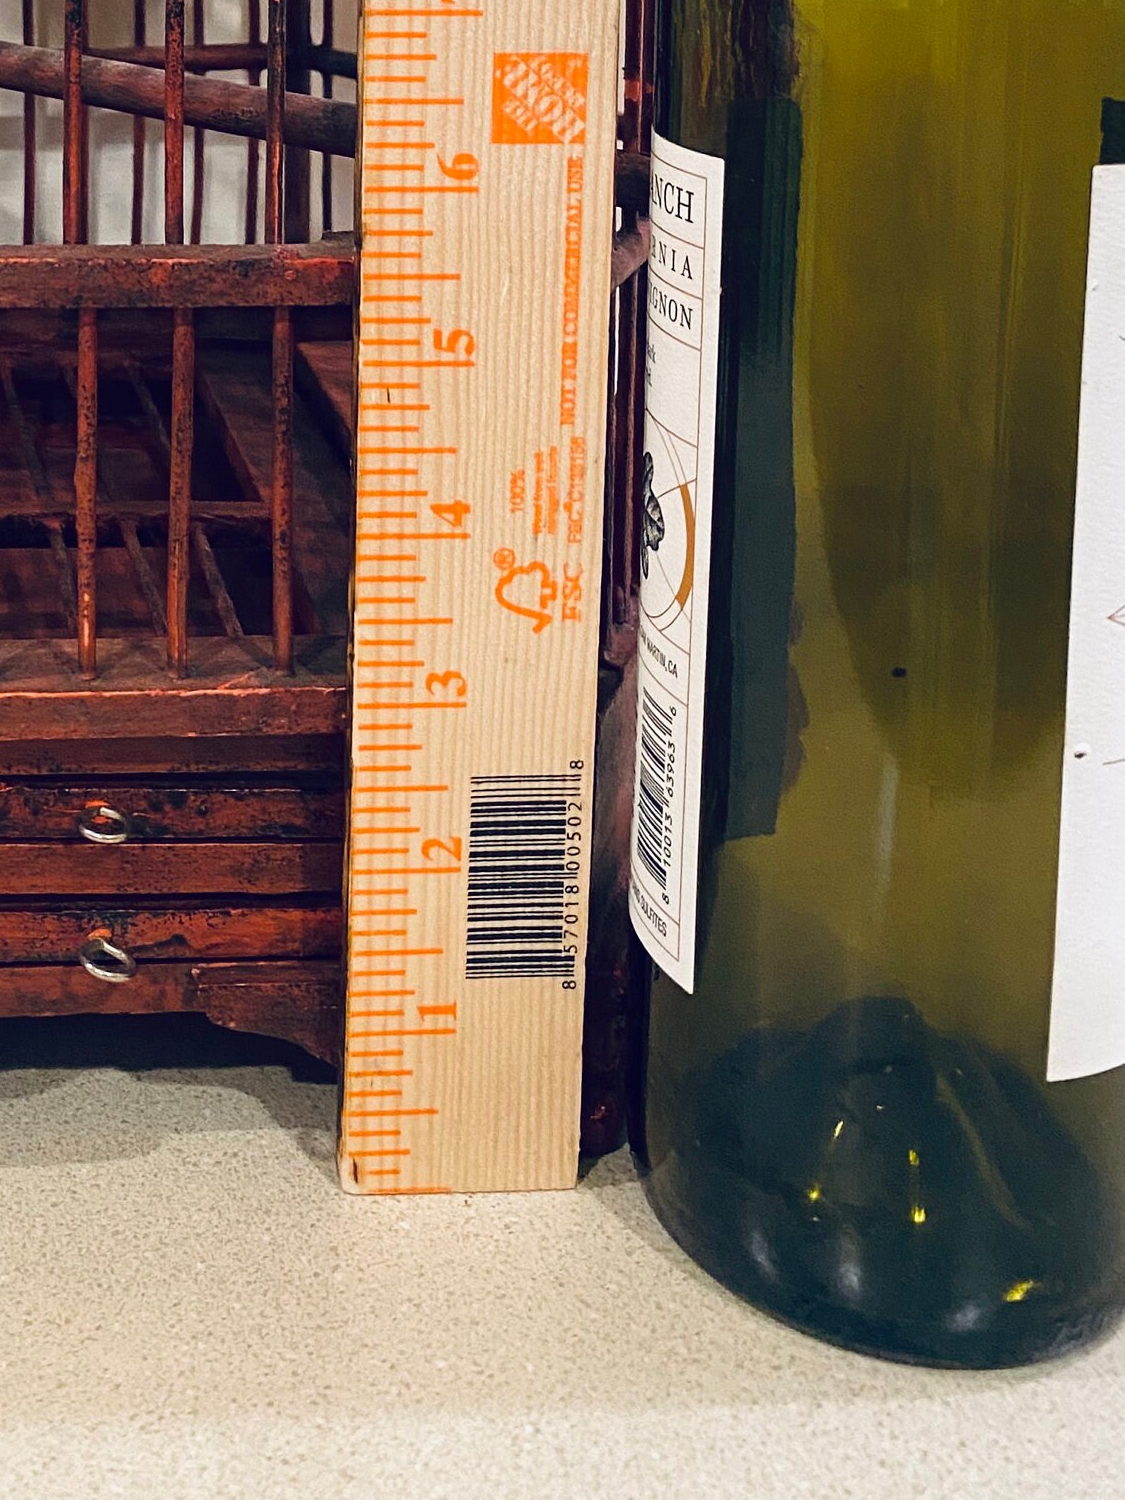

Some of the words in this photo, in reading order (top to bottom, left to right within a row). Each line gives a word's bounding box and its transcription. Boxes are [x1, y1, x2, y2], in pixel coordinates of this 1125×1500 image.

[436, 152, 479, 180] 6
[433, 328, 475, 355] 5
[430, 500, 471, 528] 4
[562, 562, 583, 622] FSC
[425, 670, 468, 698] 3
[421, 835, 462, 863] 2
[416, 1001, 457, 1022] 1
